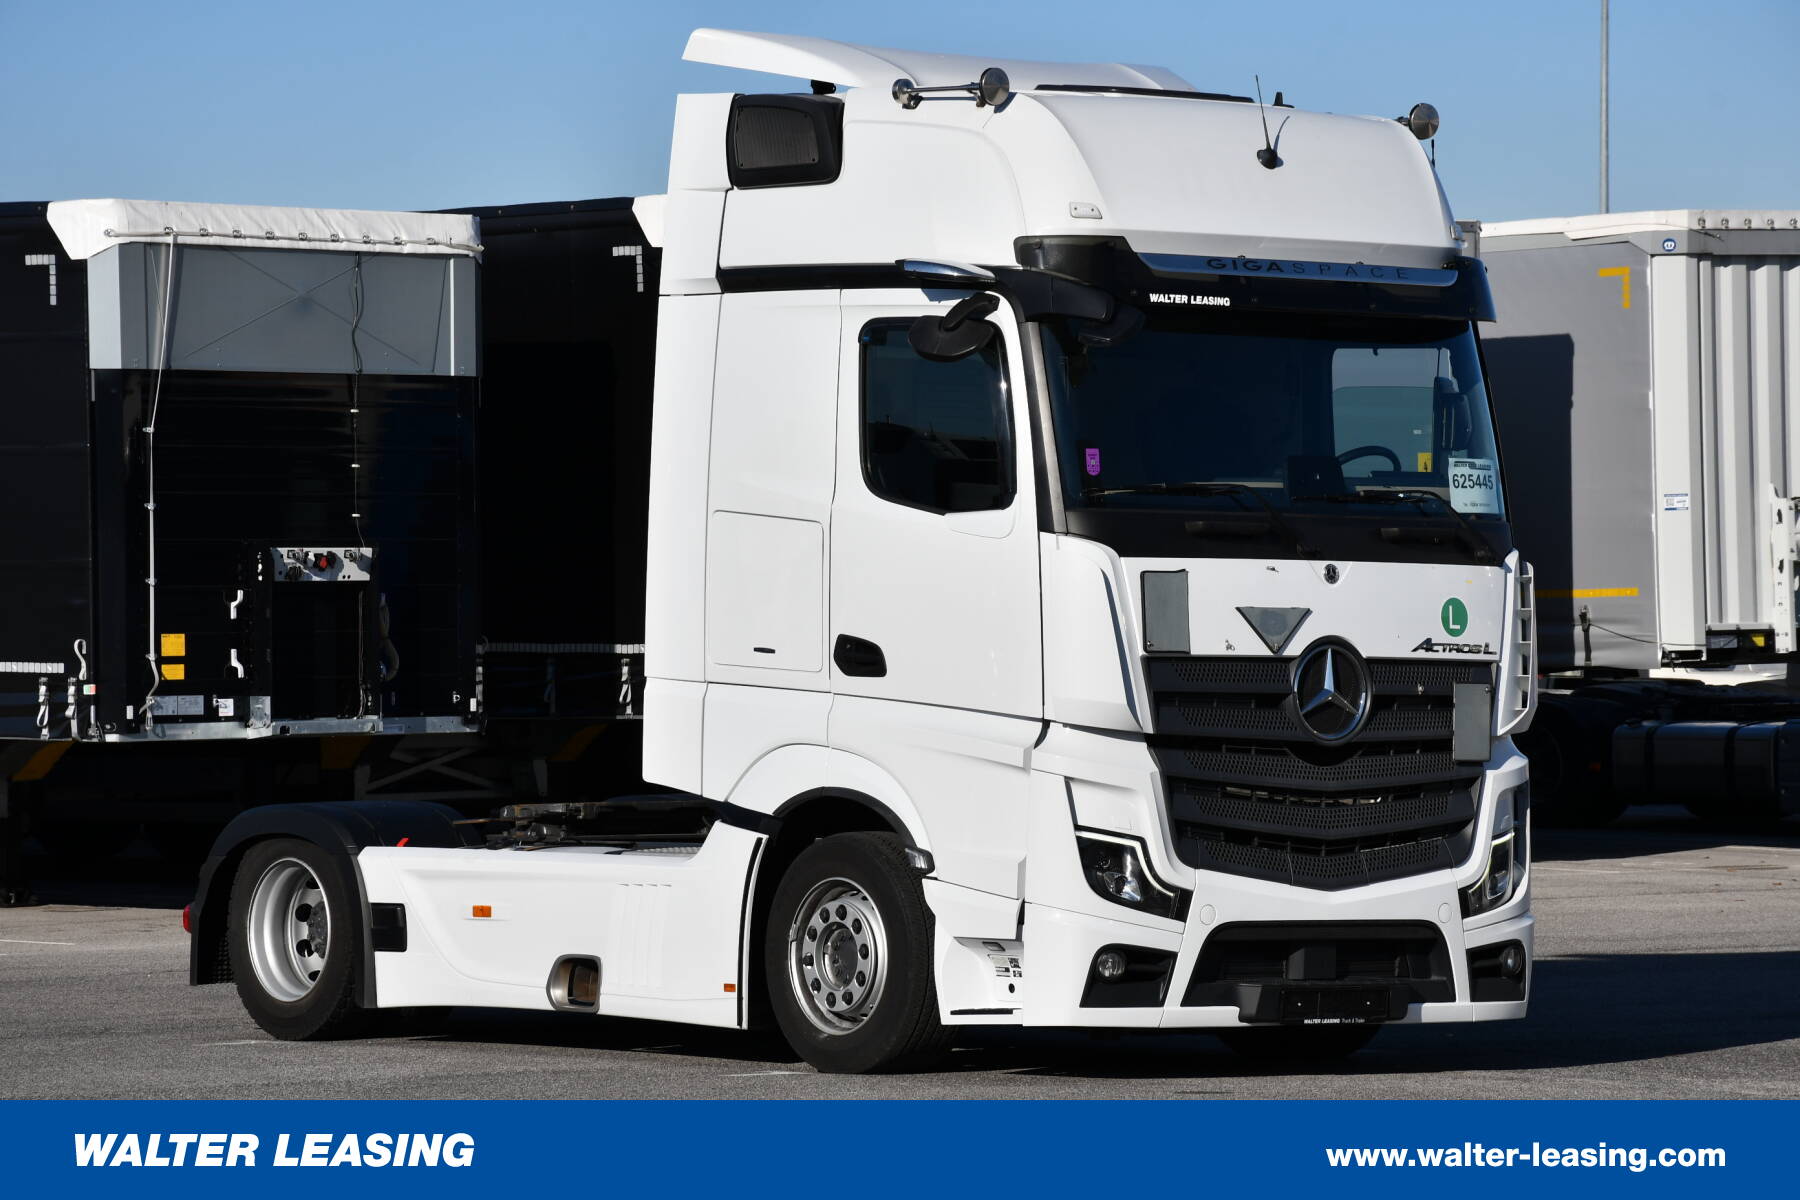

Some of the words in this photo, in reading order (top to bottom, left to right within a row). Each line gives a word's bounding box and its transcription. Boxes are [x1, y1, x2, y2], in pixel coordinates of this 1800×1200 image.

[1149, 293, 1188, 304] WALTER
[1190, 295, 1231, 307] LEASING
[1452, 473, 1494, 490] 625445
[1448, 605, 1461, 630] L
